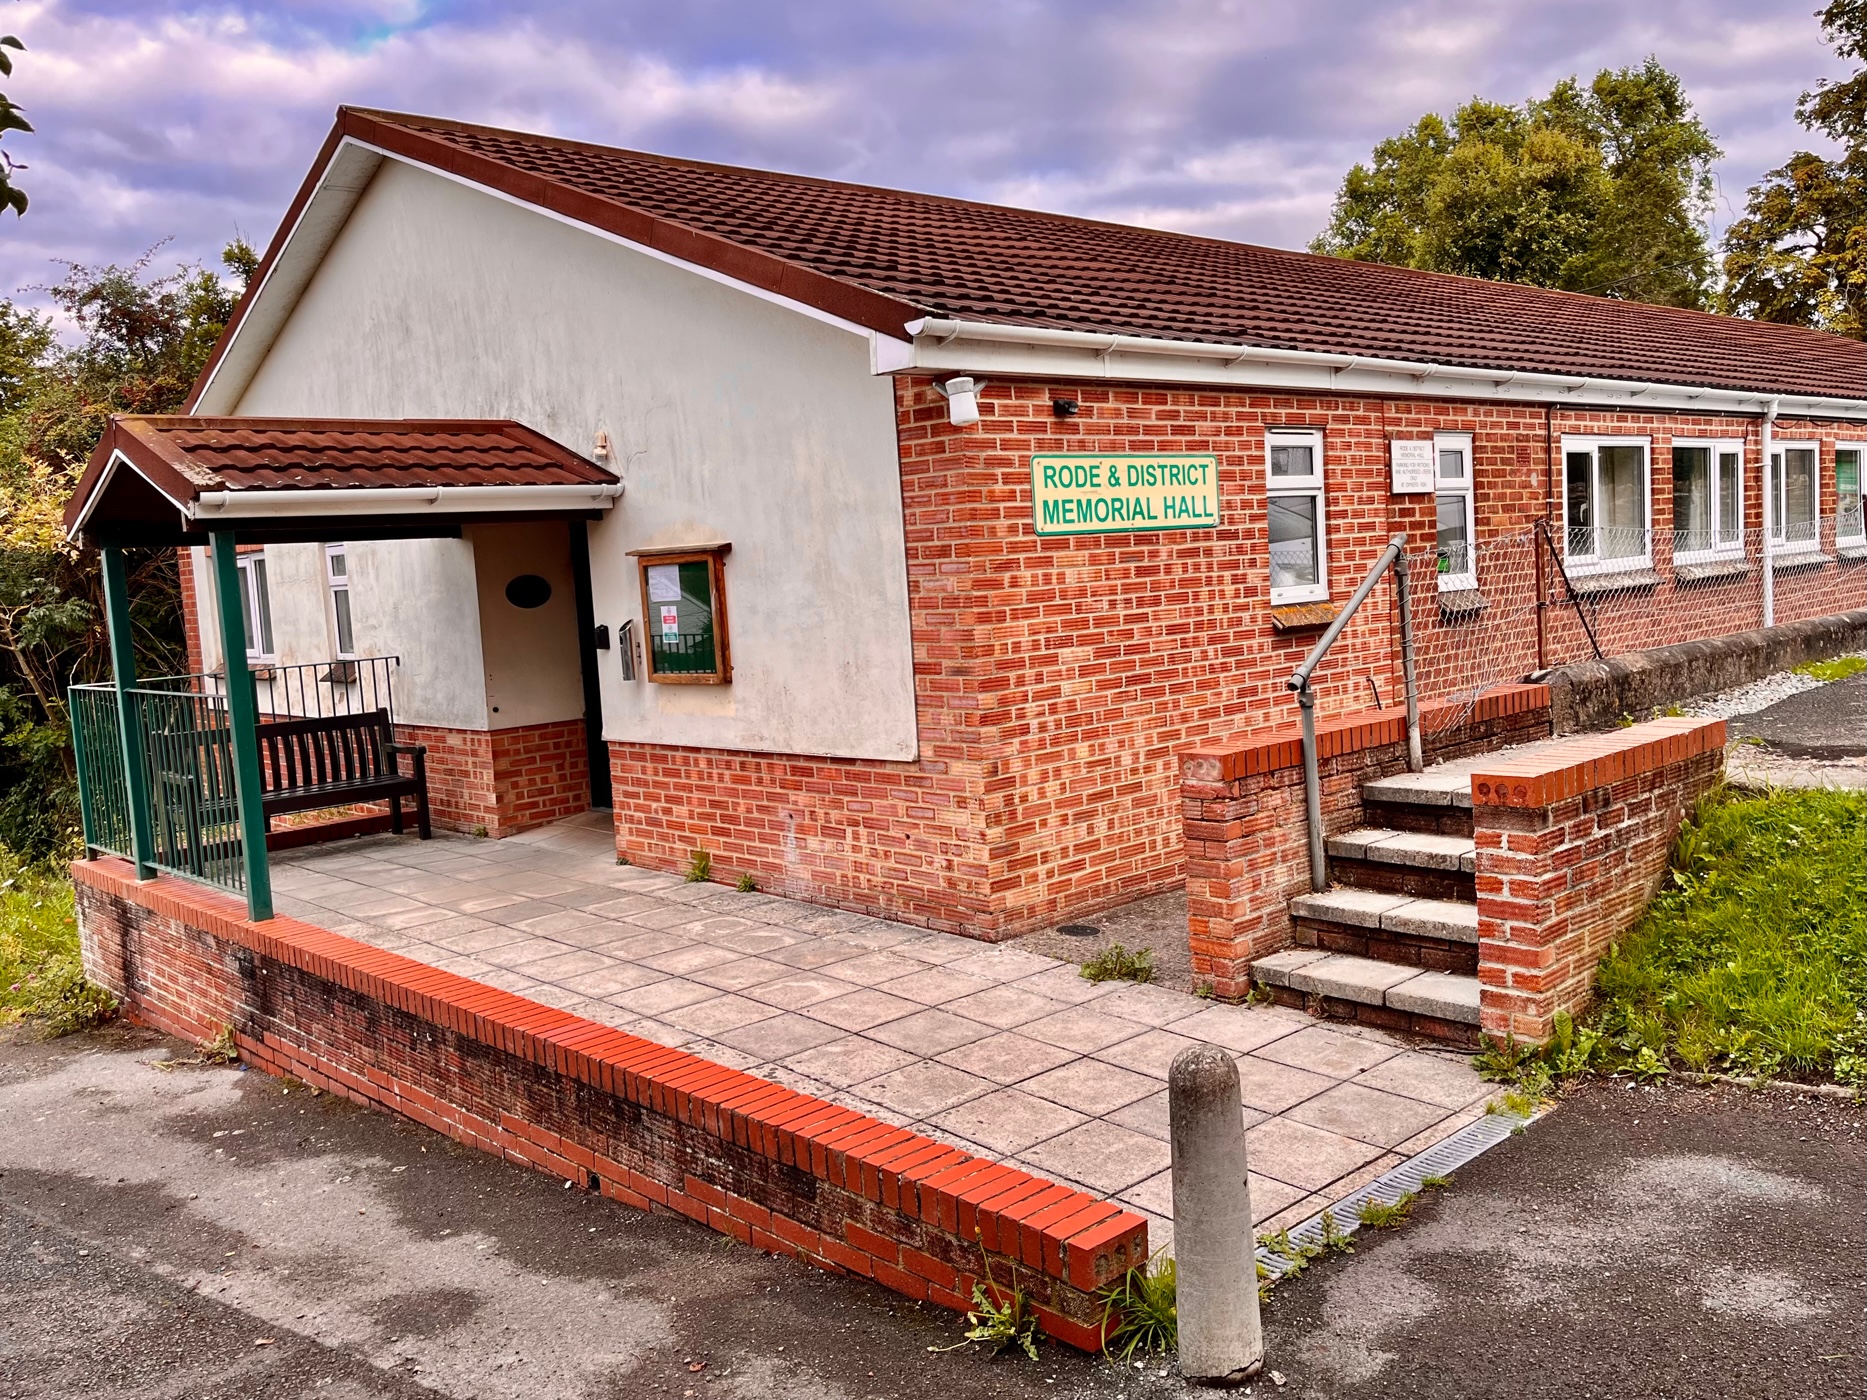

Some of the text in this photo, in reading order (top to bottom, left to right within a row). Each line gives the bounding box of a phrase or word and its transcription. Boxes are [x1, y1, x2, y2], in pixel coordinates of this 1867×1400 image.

[1043, 464, 1209, 488] RODE & DISTRICT
[1042, 495, 1214, 525] MEMORIAL HALL
